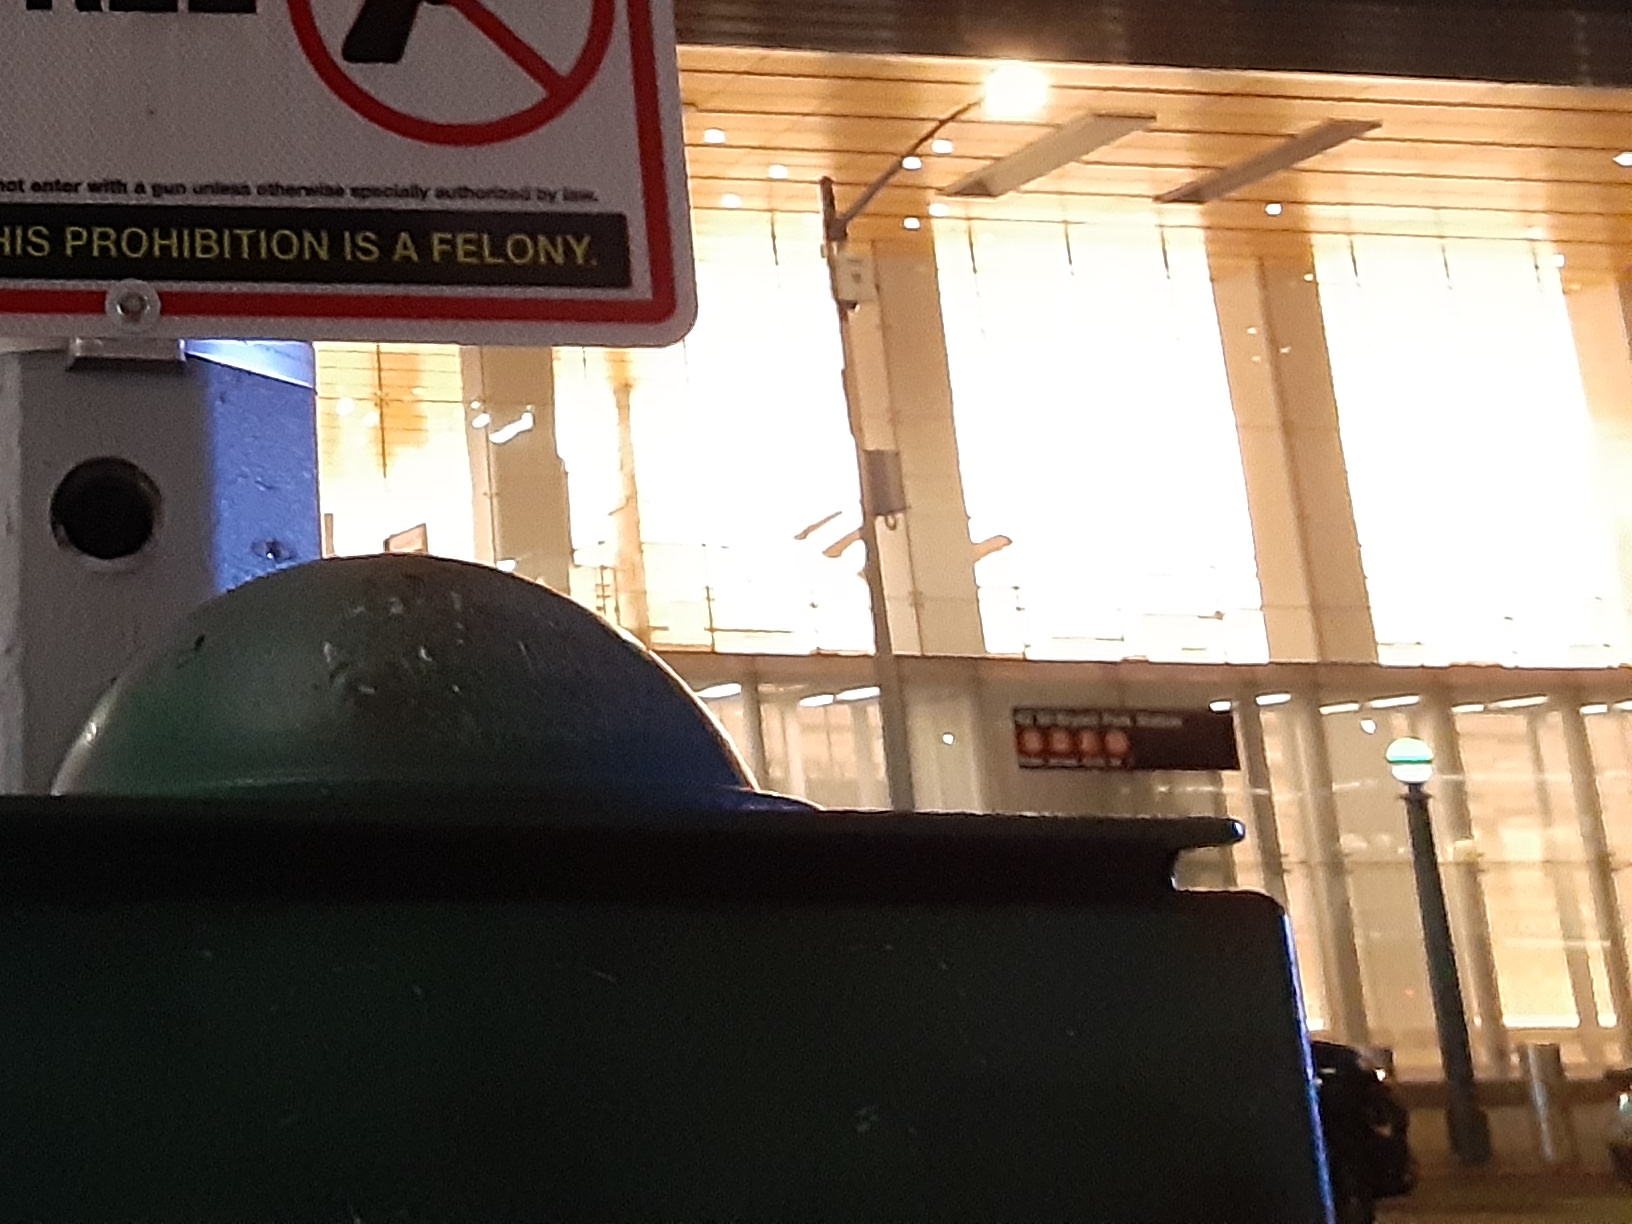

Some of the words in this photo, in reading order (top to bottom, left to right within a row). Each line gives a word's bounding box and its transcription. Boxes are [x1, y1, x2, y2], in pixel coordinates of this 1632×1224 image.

[30, 178, 82, 194] enter
[87, 178, 128, 195] with
[134, 181, 147, 195] a
[151, 182, 187, 198] gun
[192, 180, 251, 196] unless
[536, 186, 558, 204] by
[66, 226, 329, 261] PROHIBITION
[344, 230, 380, 263] IS
[393, 232, 419, 263] A
[432, 232, 598, 267] FELONY.
